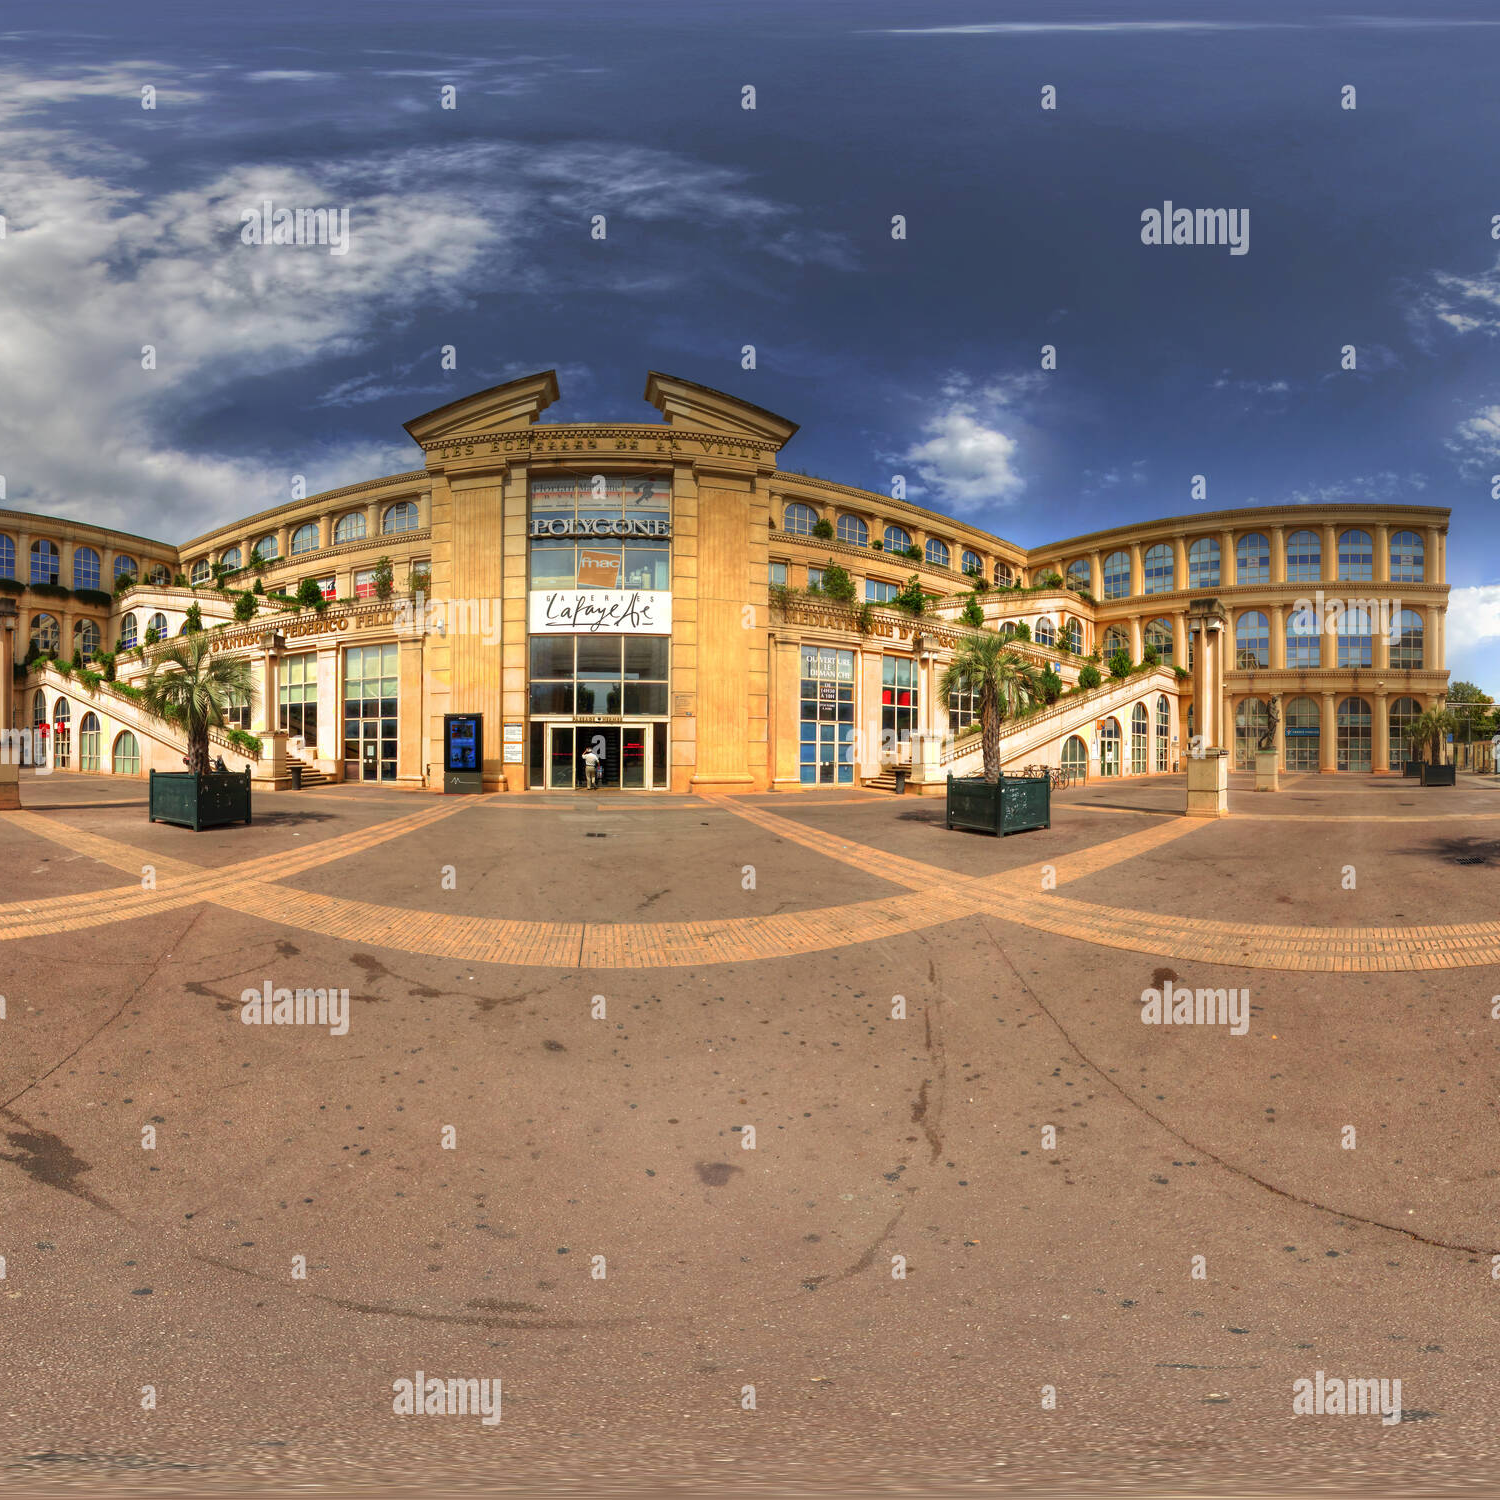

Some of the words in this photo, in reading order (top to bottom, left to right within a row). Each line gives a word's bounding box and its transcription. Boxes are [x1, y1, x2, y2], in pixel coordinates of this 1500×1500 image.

[440, 445, 474, 459] LES
[490, 438, 597, 453] ECHELLES
[615, 438, 639, 450] DE
[656, 437, 682, 451] LA
[700, 441, 760, 460] VILLE
[531, 518, 669, 536] POLYGONE
[581, 557, 620, 568] fnac
[546, 594, 655, 602] GALERIES
[545, 592, 654, 632] Lafayette
[283, 617, 348, 639] FEDERICO
